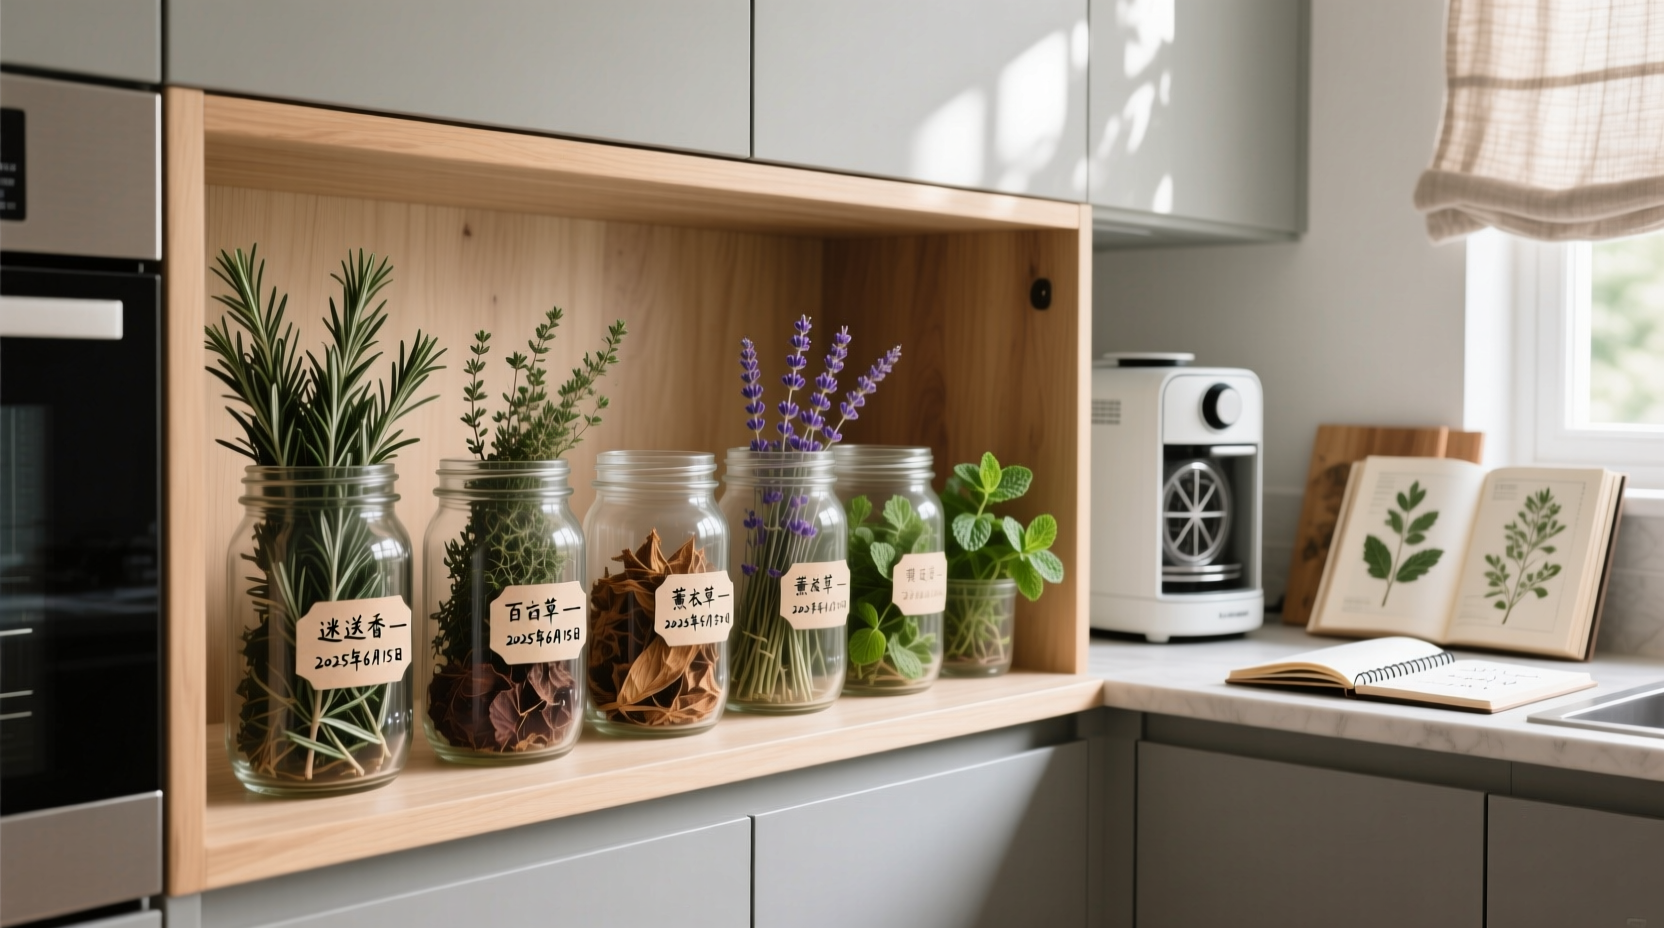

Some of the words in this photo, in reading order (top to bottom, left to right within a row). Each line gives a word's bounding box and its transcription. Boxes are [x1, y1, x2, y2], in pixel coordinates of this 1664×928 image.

[505, 626, 580, 648] 2025年6月15日
[314, 647, 403, 672] 2025年6月15日
